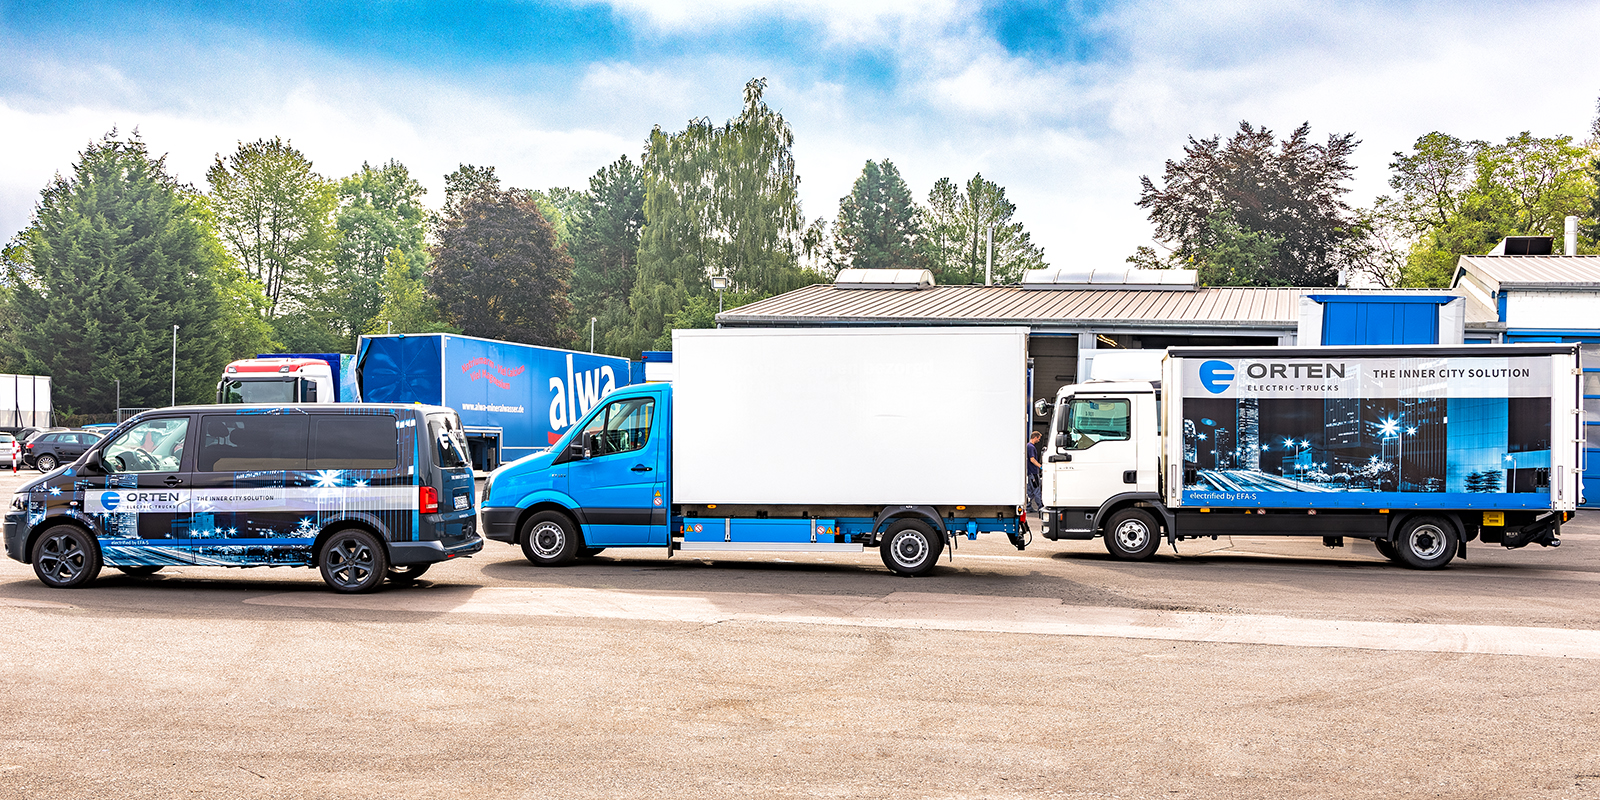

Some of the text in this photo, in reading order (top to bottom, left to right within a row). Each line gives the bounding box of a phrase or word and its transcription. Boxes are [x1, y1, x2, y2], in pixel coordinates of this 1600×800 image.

[470, 369, 481, 382] Viel
[497, 364, 507, 376] Viel
[507, 365, 526, 377] Calcium
[1247, 363, 1345, 379] ORTEN
[1373, 368, 1530, 379] THE INNER CITY SOLUTION
[549, 353, 616, 431] alwa
[1247, 384, 1339, 392] ELECTRIC-TRUCKS
[462, 402, 525, 414] www.alwa-mineralwasser.de
[126, 492, 179, 502] ORTEN
[1189, 492, 1225, 500] electrified
[1226, 493, 1235, 501] by
